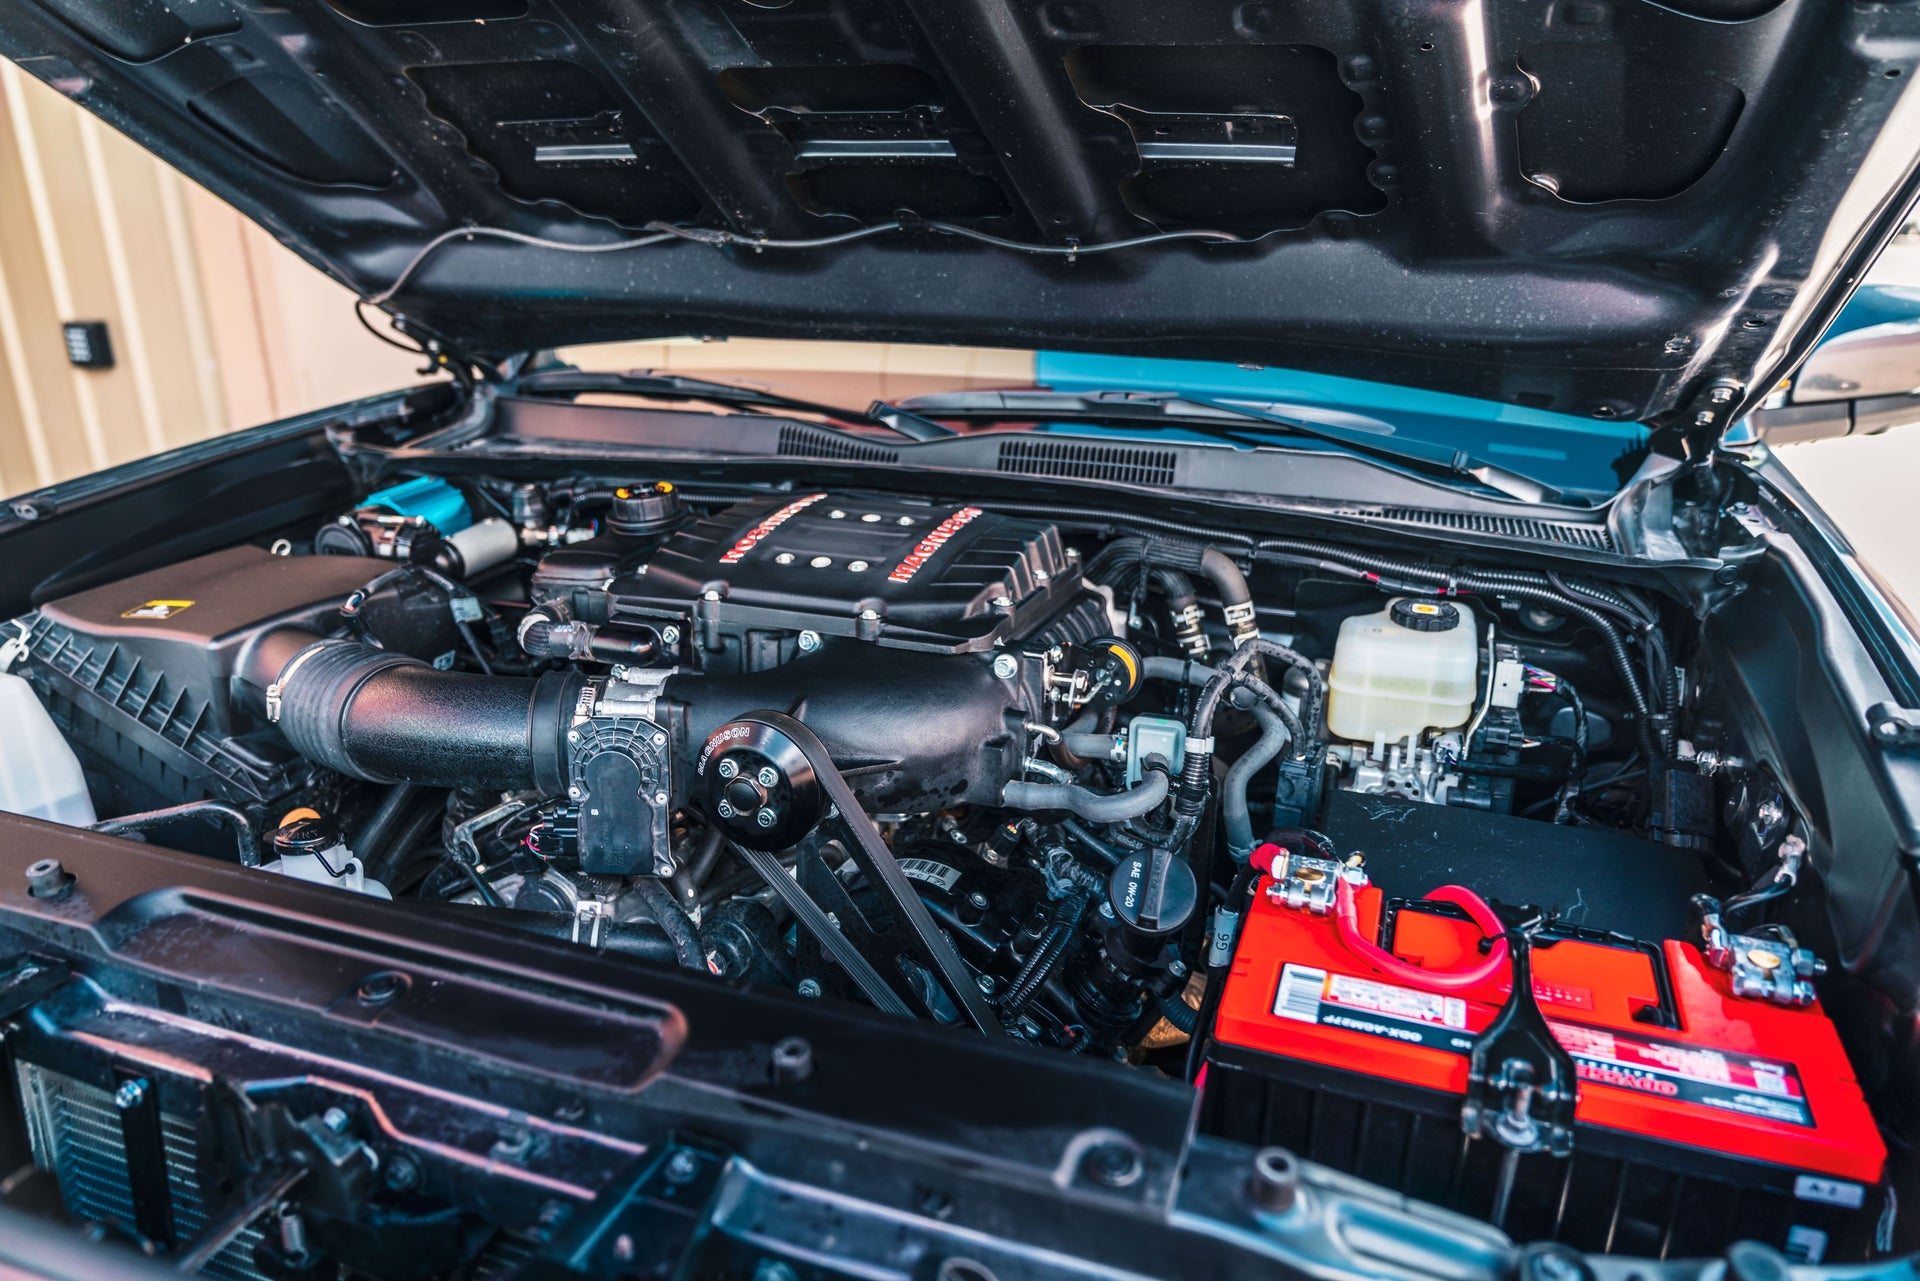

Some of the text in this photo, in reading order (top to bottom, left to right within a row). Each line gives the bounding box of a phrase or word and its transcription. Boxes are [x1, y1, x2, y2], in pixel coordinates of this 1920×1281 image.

[888, 506, 983, 583] MAGNUSON
[697, 726, 750, 776] MAGNUSON
[1131, 861, 1142, 879] SAE
[1124, 881, 1138, 908] 0W-20
[1216, 933, 1230, 951] G6
[1575, 1065, 1679, 1096] ODYSSE
